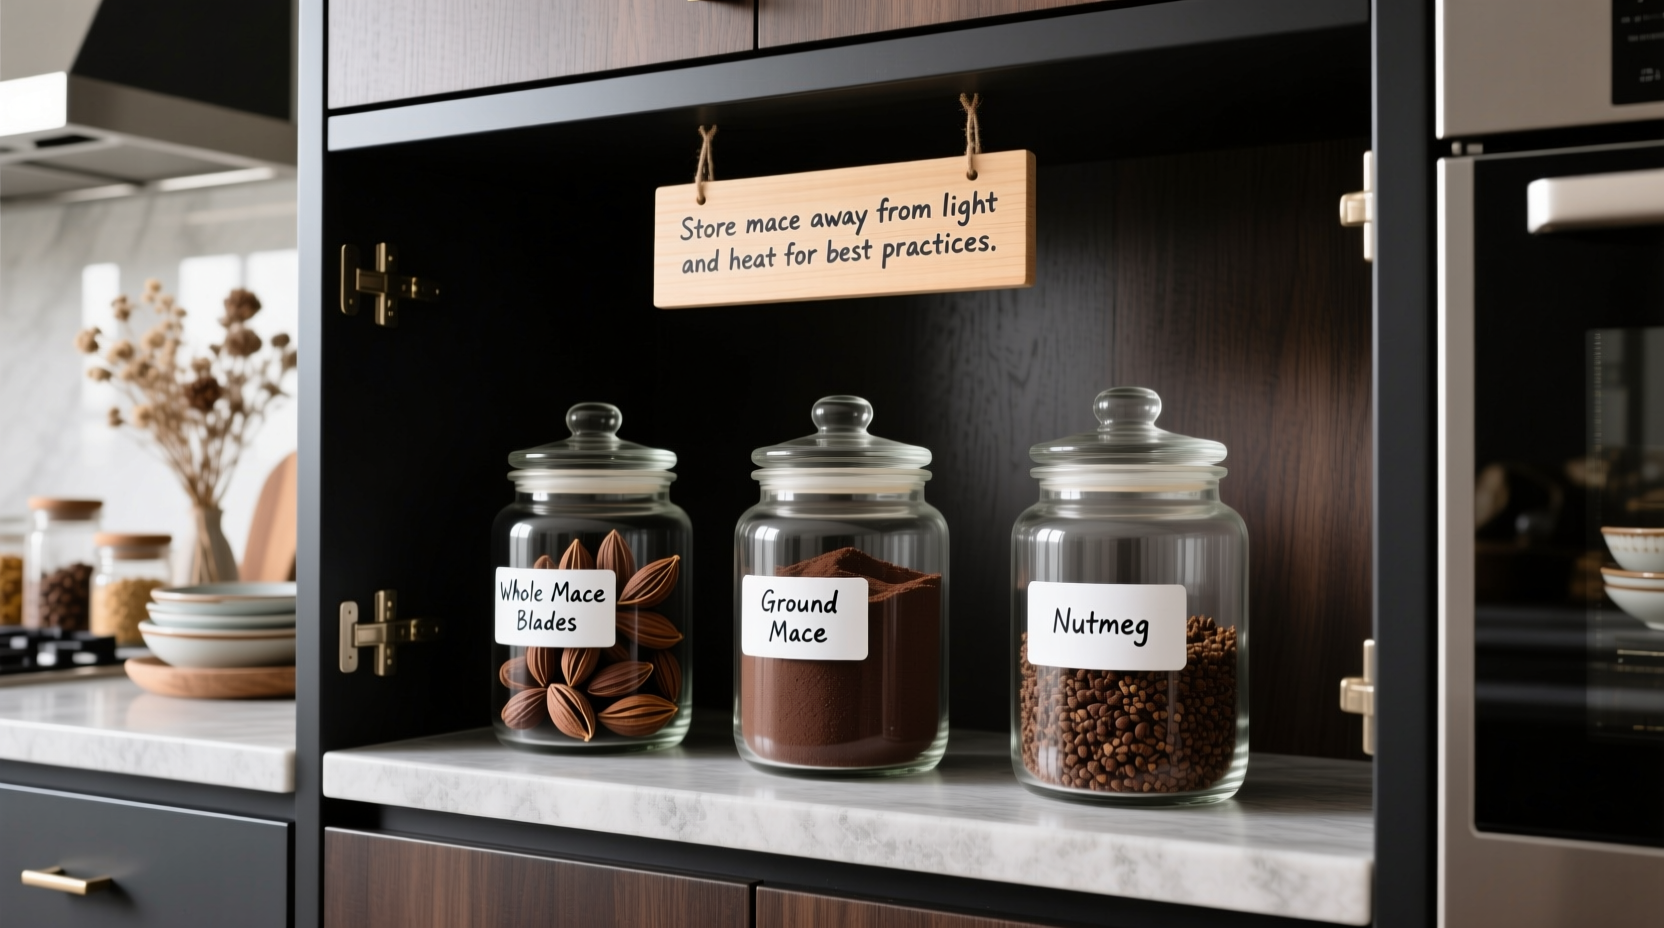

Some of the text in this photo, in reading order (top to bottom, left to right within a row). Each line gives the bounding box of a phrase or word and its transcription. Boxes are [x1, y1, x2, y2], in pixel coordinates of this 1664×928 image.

[680, 190, 998, 241] Store mace away from light
[681, 232, 997, 274] and heat for best practices.
[500, 578, 606, 603] Whole Mace
[761, 588, 839, 615] Ground
[516, 609, 577, 632] Blades
[768, 620, 828, 644] Mace
[1053, 606, 1149, 648] Nutmeg
